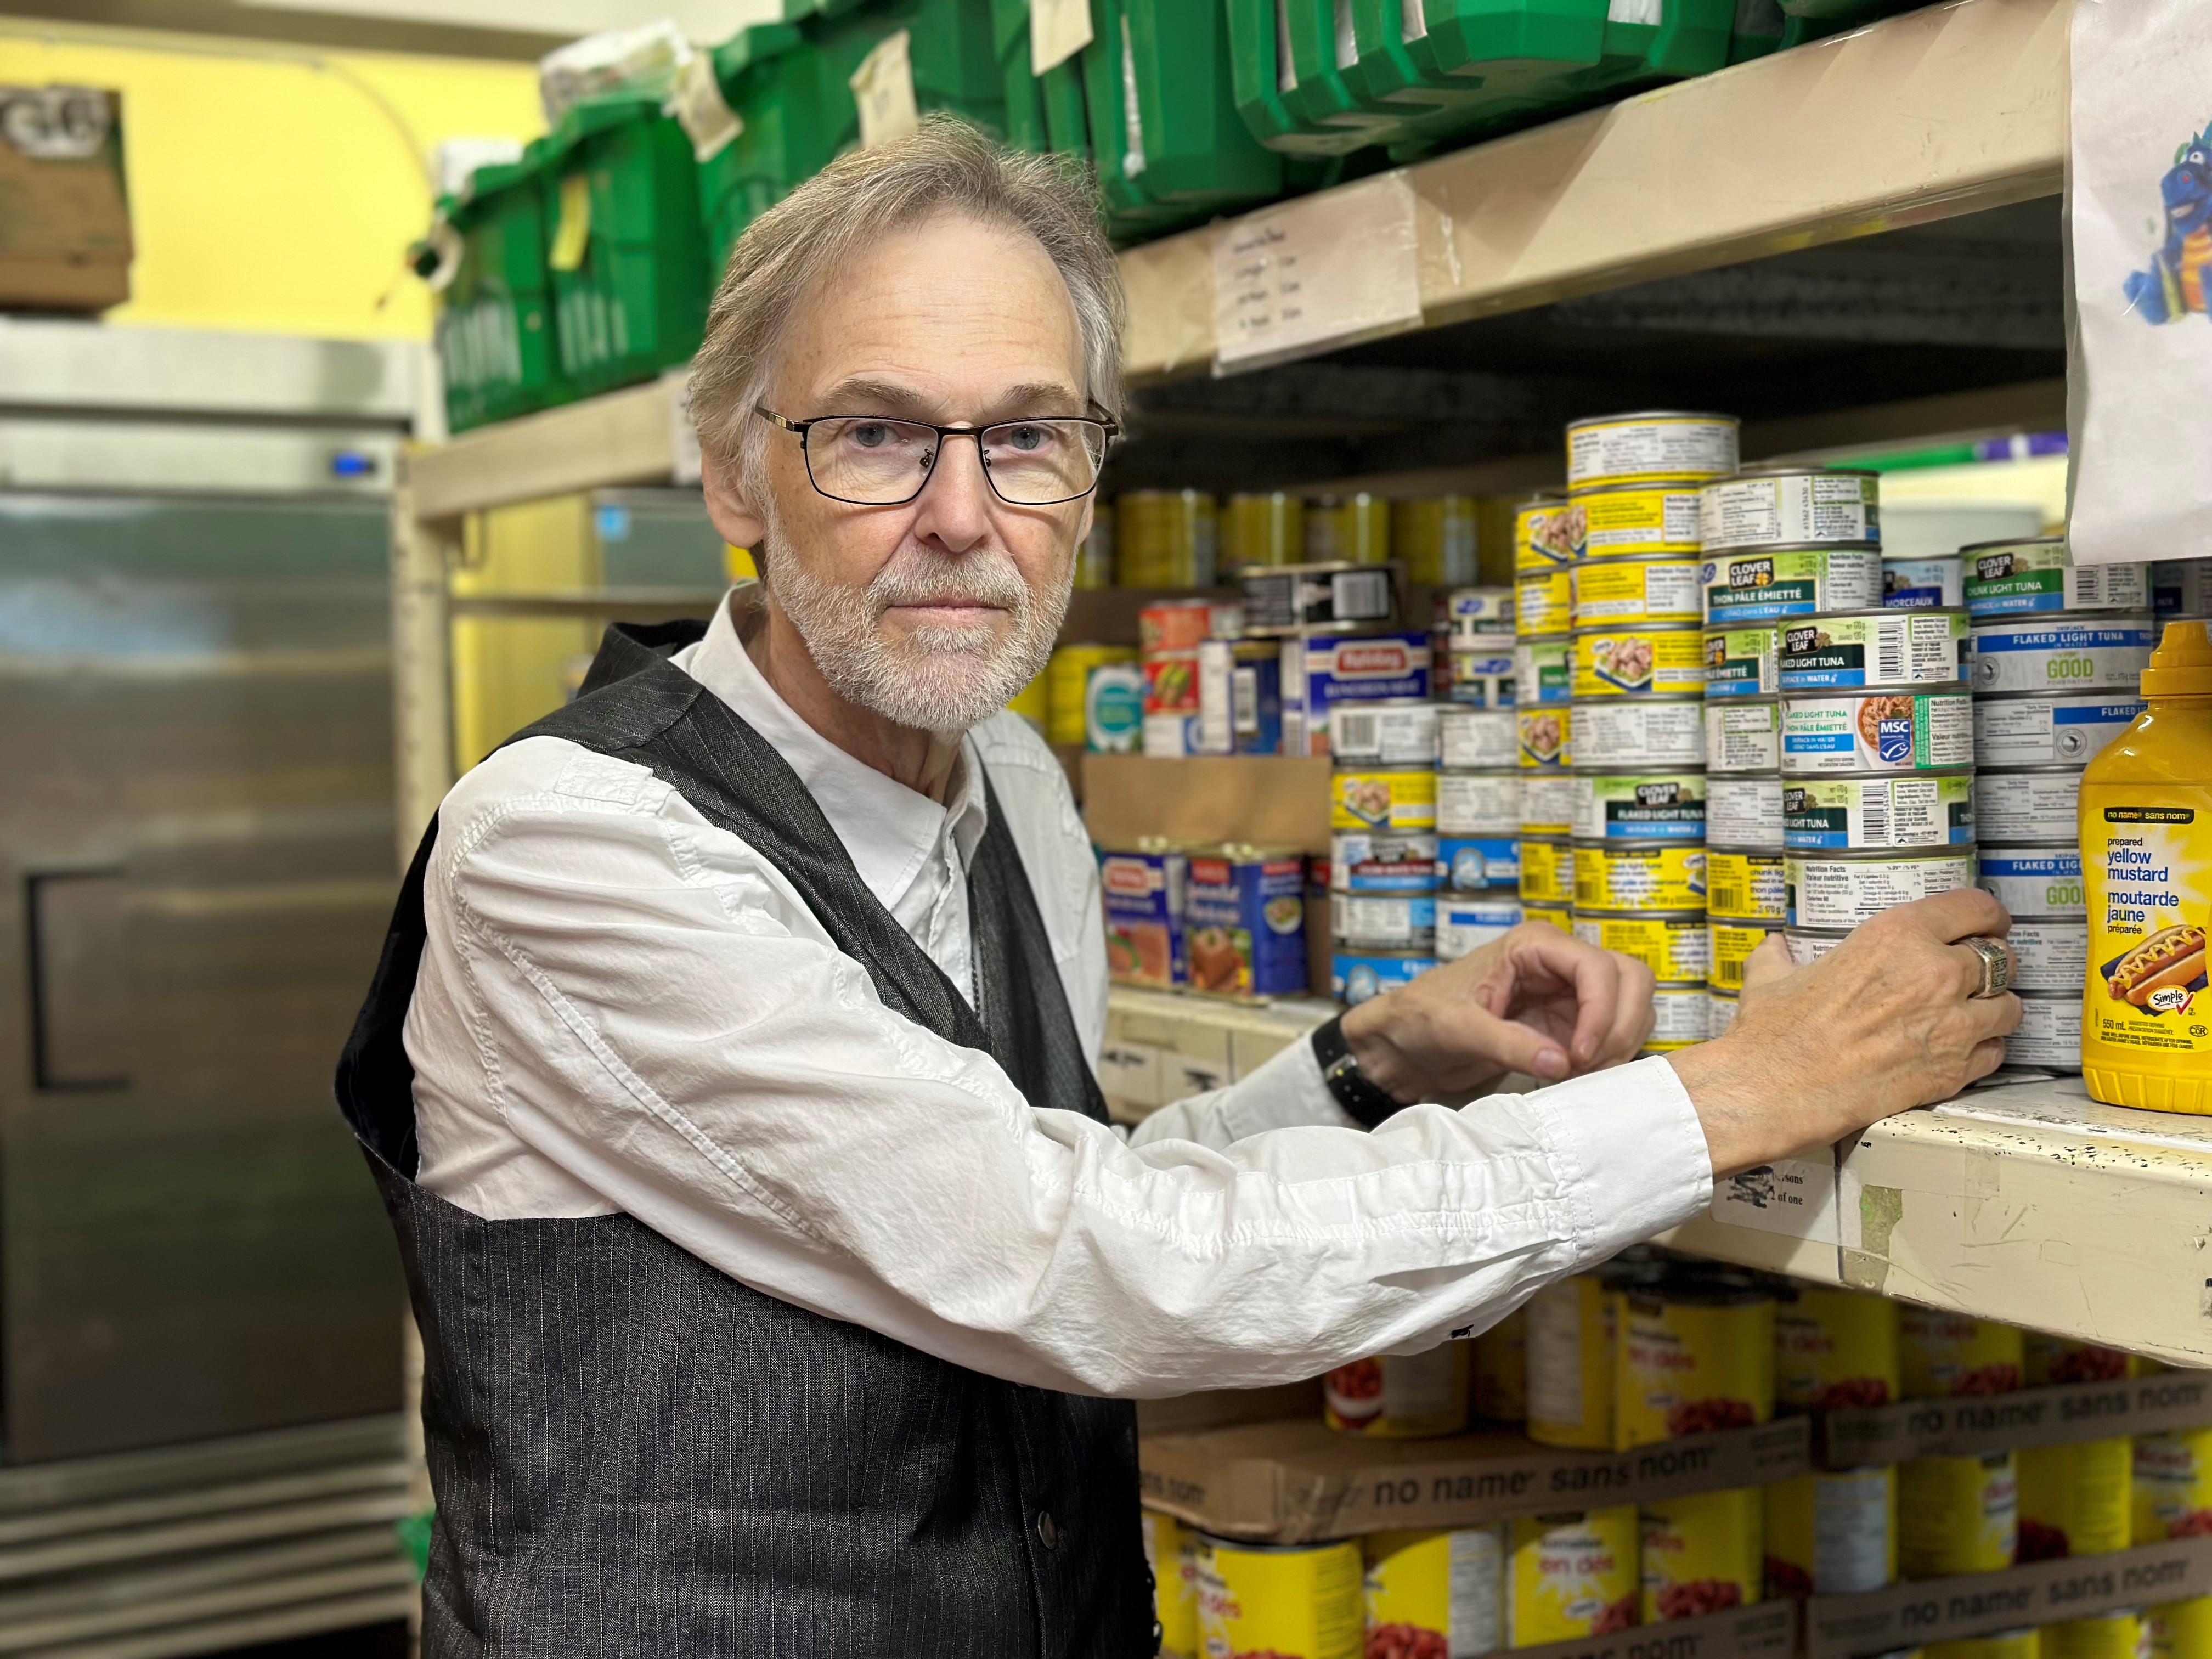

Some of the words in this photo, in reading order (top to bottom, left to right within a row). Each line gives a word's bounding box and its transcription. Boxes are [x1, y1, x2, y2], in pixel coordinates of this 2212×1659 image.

[1730, 561, 1771, 576] CLOVER
[1978, 555, 2011, 570] CLOVER
[1731, 573, 1756, 586] LEAF
[1985, 568, 2005, 578] LEAF
[1989, 584, 2012, 594] LIGHT
[2016, 582, 2042, 591] TUNA
[1714, 595, 1733, 604] THON
[1735, 591, 1756, 602] PÂLE
[1758, 589, 1801, 601] ÉMIETTÉ
[1787, 630, 1815, 642] CLOVER
[2013, 633, 2056, 645] FLAKED
[2061, 633, 2094, 642] LIGHT
[2098, 632, 2124, 641] TUNA
[1792, 641, 1808, 652] LEAF
[1796, 659, 1817, 667] LIGHT
[1819, 657, 1844, 667] TUNA
[2047, 658, 2094, 679] GOOD
[2102, 707, 2135, 716] FLAKED
[1800, 723, 1815, 731] PÂLE
[1816, 723, 1848, 731] ÉMIETTÉ
[1880, 721, 1909, 733] MSC
[1786, 802, 1799, 811] LEAF
[1790, 820, 1805, 828] LIGHT
[1806, 819, 1829, 827] TUNA
[2107, 838, 2142, 847] prepared
[2107, 848, 2152, 866] yellow
[2013, 861, 2055, 870] FLAKED
[2108, 867, 2168, 882] mustard
[2046, 886, 2085, 905] GOO
[2108, 891, 2179, 906] moutarde
[2107, 905, 2145, 923] jaune
[2108, 924, 2142, 934] préparée
[2153, 990, 2183, 1005] Simple
[2103, 1019, 2114, 1029] 550
[1778, 1192, 1787, 1202] of
[1788, 1196, 1803, 1205] one
[1907, 1408, 1944, 1435] no
[1956, 1402, 2043, 1431] name
[2061, 1390, 2129, 1422] sans
[2139, 1386, 2200, 1409] nom
[1373, 1477, 1420, 1508] no
[1432, 1469, 1530, 1502] name
[1550, 1460, 1632, 1493] sans
[1638, 1448, 1707, 1480] nom
[1539, 1556, 1569, 1573] en
[1576, 1553, 1614, 1574] dés
[1900, 1602, 1939, 1628] no
[1949, 1589, 2029, 1618] name
[2047, 1571, 2113, 1606] sans
[2123, 1560, 2186, 1590] nom
